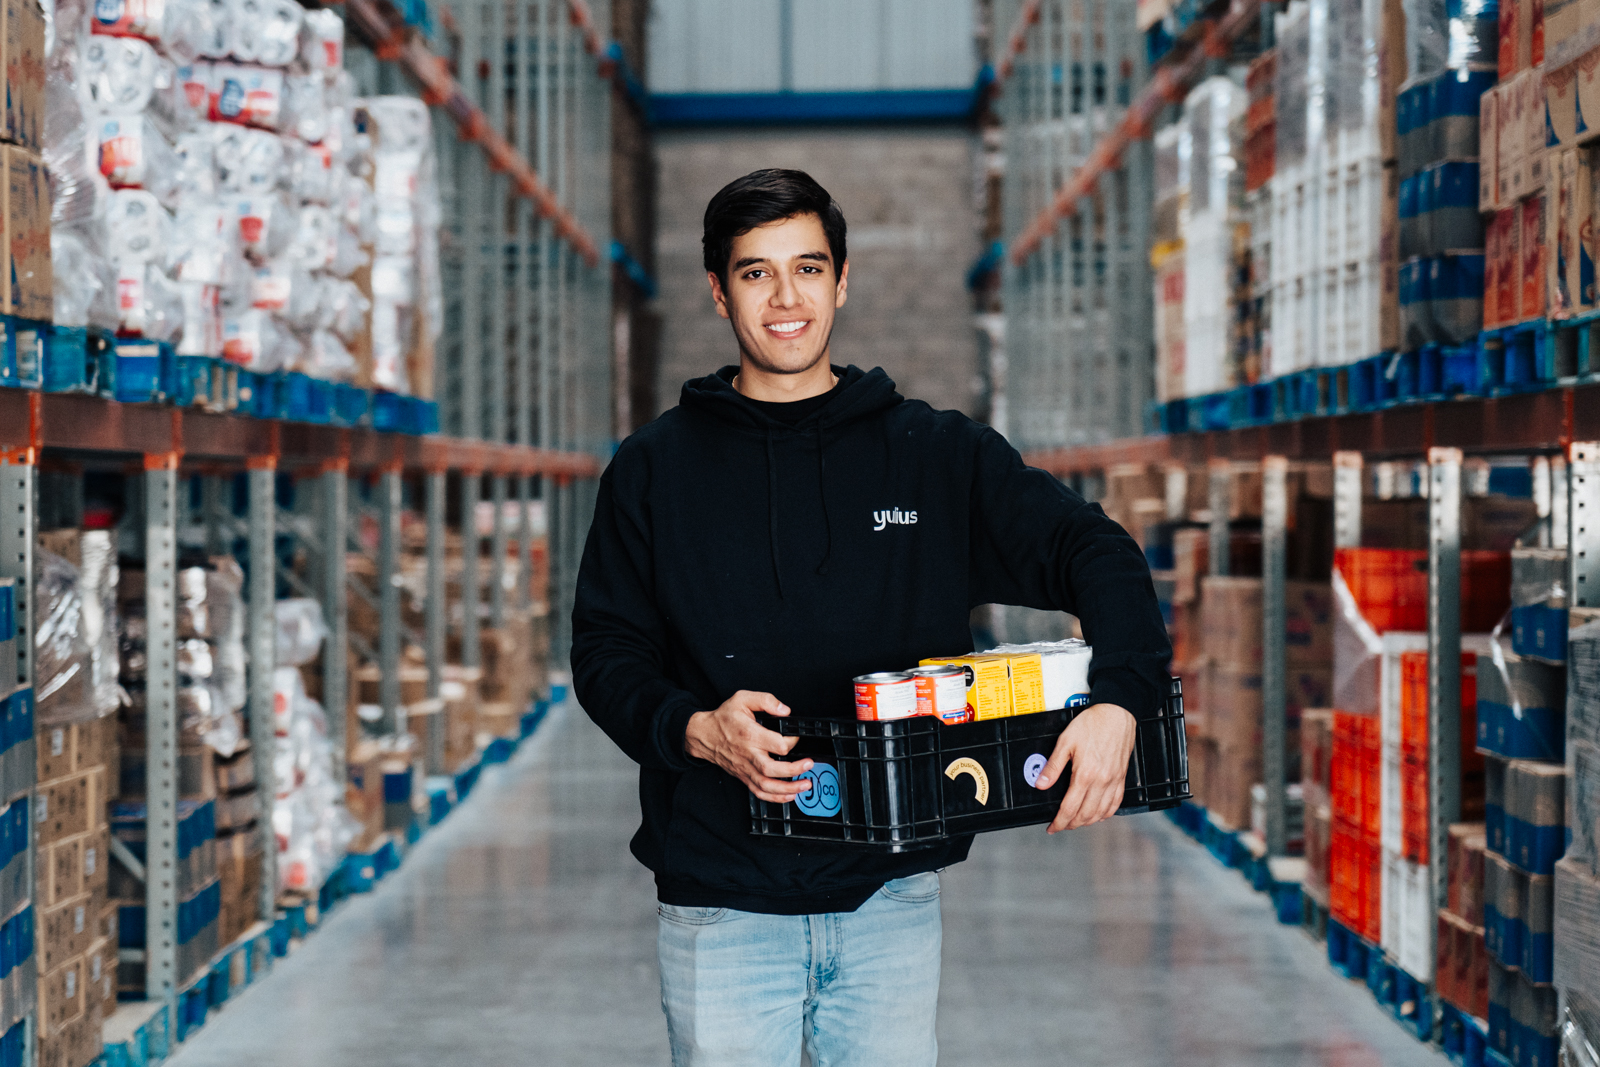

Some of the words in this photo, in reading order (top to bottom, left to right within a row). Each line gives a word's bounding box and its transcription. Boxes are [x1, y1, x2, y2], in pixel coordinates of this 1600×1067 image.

[949, 763, 960, 778] your
[960, 762, 982, 777] business
[978, 775, 987, 801] partner
